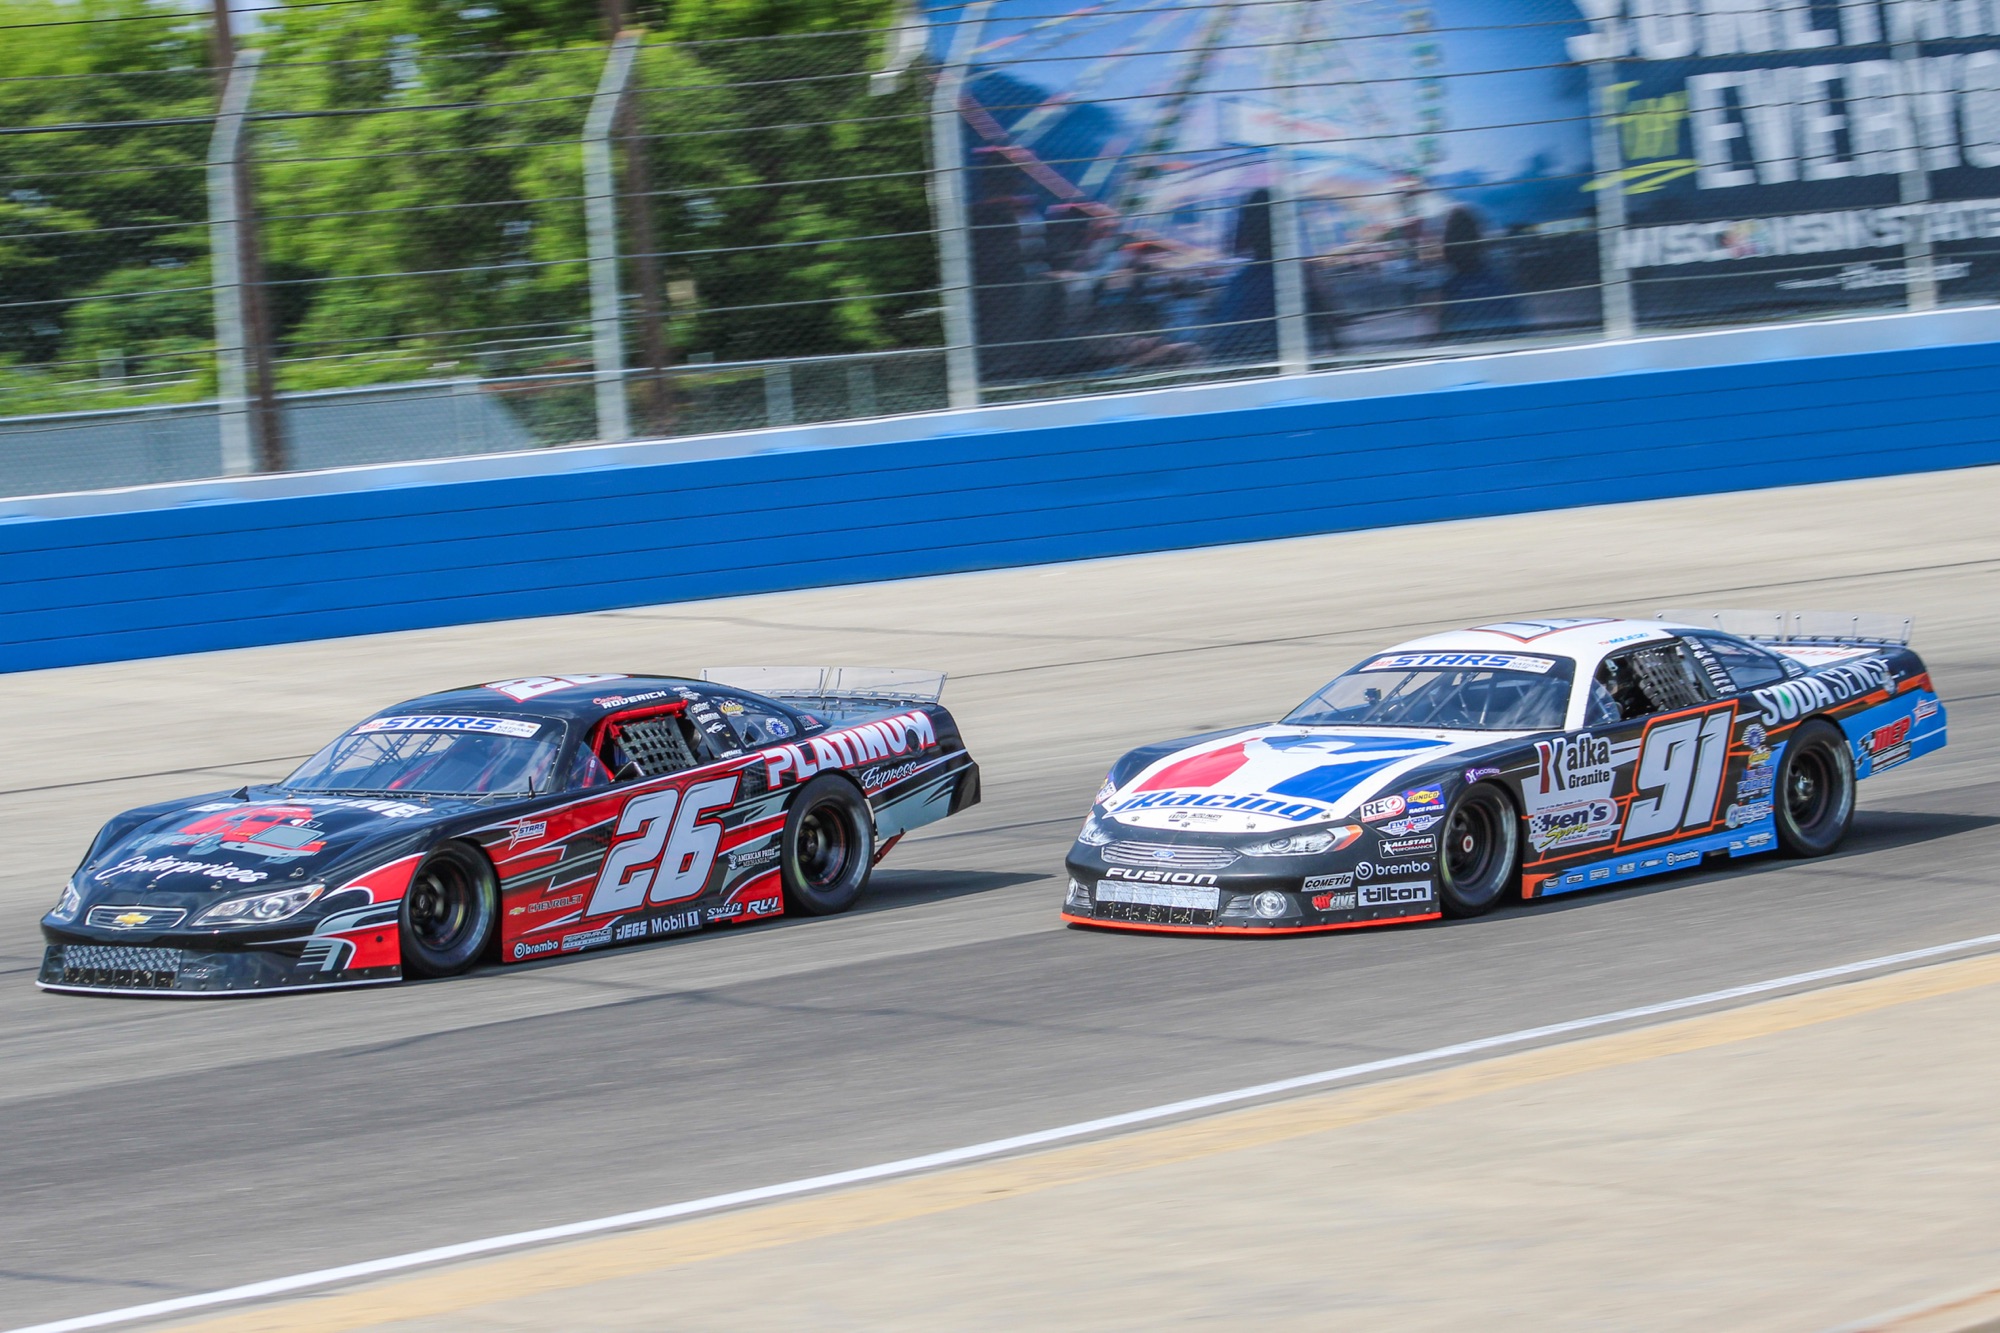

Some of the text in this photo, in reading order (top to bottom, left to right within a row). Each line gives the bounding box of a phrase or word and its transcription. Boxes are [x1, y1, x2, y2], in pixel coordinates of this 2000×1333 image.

[1391, 654, 1517, 667] STARS
[602, 690, 667, 709] RODERICK
[1752, 672, 1836, 727] SODA
[379, 716, 503, 730] STARS
[1872, 715, 1912, 753] MEP
[762, 710, 937, 791] PLATINUM
[1475, 767, 1500, 776] HOOSIER
[1536, 736, 1609, 794] Kafka
[862, 761, 917, 790] Express
[1569, 769, 1610, 789] Granite
[1621, 711, 1732, 842] 91
[1113, 790, 1327, 821] iRacing
[1408, 791, 1438, 802] SUNOCO
[1426, 804, 1444, 812] FUELS
[1390, 815, 1431, 829] FIVE STAR
[1541, 802, 1608, 833] ken's
[519, 822, 545, 835] STARS
[1539, 823, 1589, 849] Sports
[585, 775, 739, 919] 26
[1392, 837, 1433, 847] ALLSTAR
[1392, 844, 1434, 852] PERFORMANCE
[738, 848, 775, 862] AMERICAN PRIDE
[1675, 850, 1699, 863] brembo
[95, 855, 268, 883] Enterprises
[1105, 867, 1220, 885] FUSION
[1376, 861, 1430, 876] brembo
[1305, 874, 1351, 889] COMETIC
[1330, 894, 1356, 909] FIVE
[1363, 884, 1427, 902] tilton
[528, 894, 583, 914] CHEVROLET
[707, 902, 743, 917] Swift
[617, 921, 647, 940] JEGS
[651, 911, 699, 934] Mobil 1
[564, 928, 611, 942] PERFORMANCE
[526, 940, 559, 955] brembo
